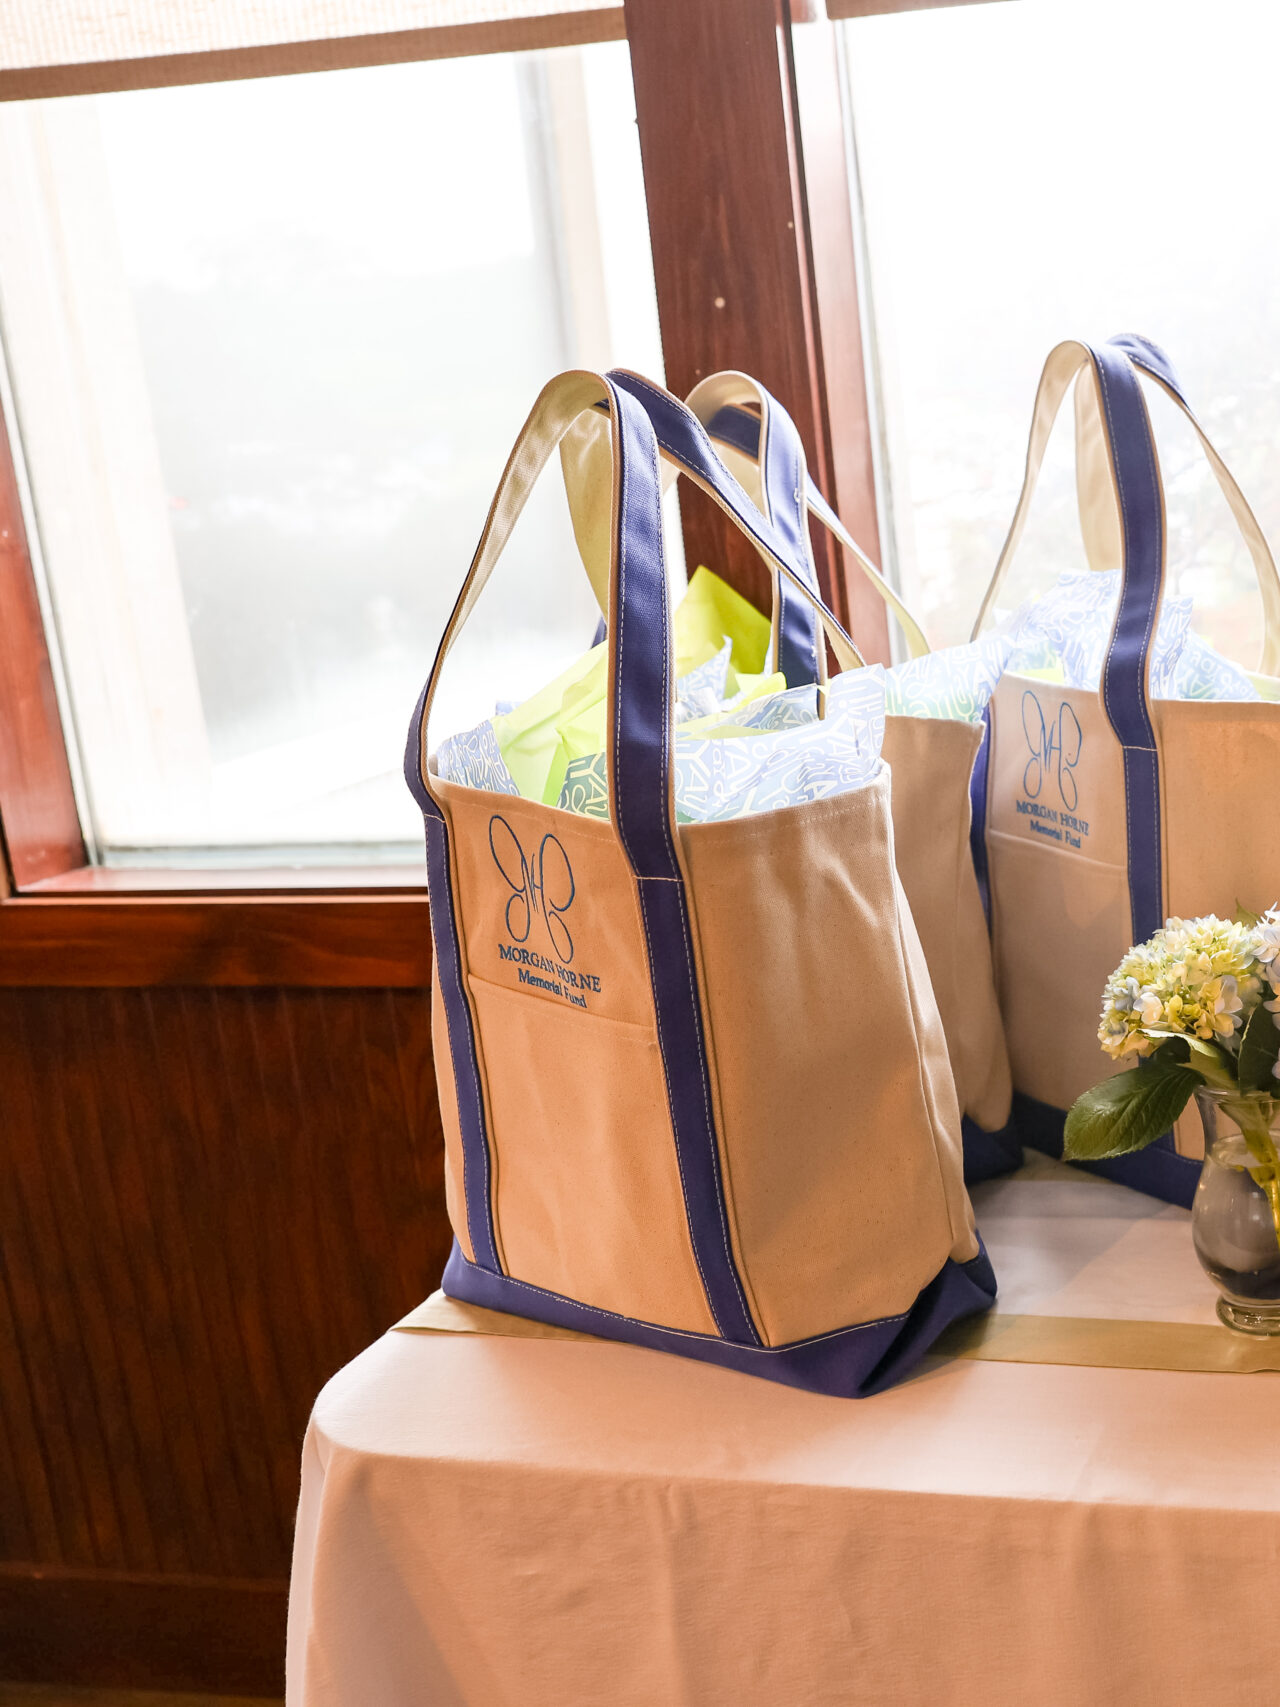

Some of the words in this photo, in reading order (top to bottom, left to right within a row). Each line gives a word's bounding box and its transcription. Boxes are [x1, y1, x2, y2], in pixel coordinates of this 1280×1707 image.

[1016, 800, 1057, 823] MORGAN
[1060, 812, 1089, 836] HORNE
[1030, 820, 1062, 841] Memorial
[1065, 831, 1081, 849] Fund
[498, 944, 554, 973] MORGAN
[554, 964, 601, 993] HORNE
[518, 968, 563, 997] Memorial
[564, 985, 588, 1009] Fund
